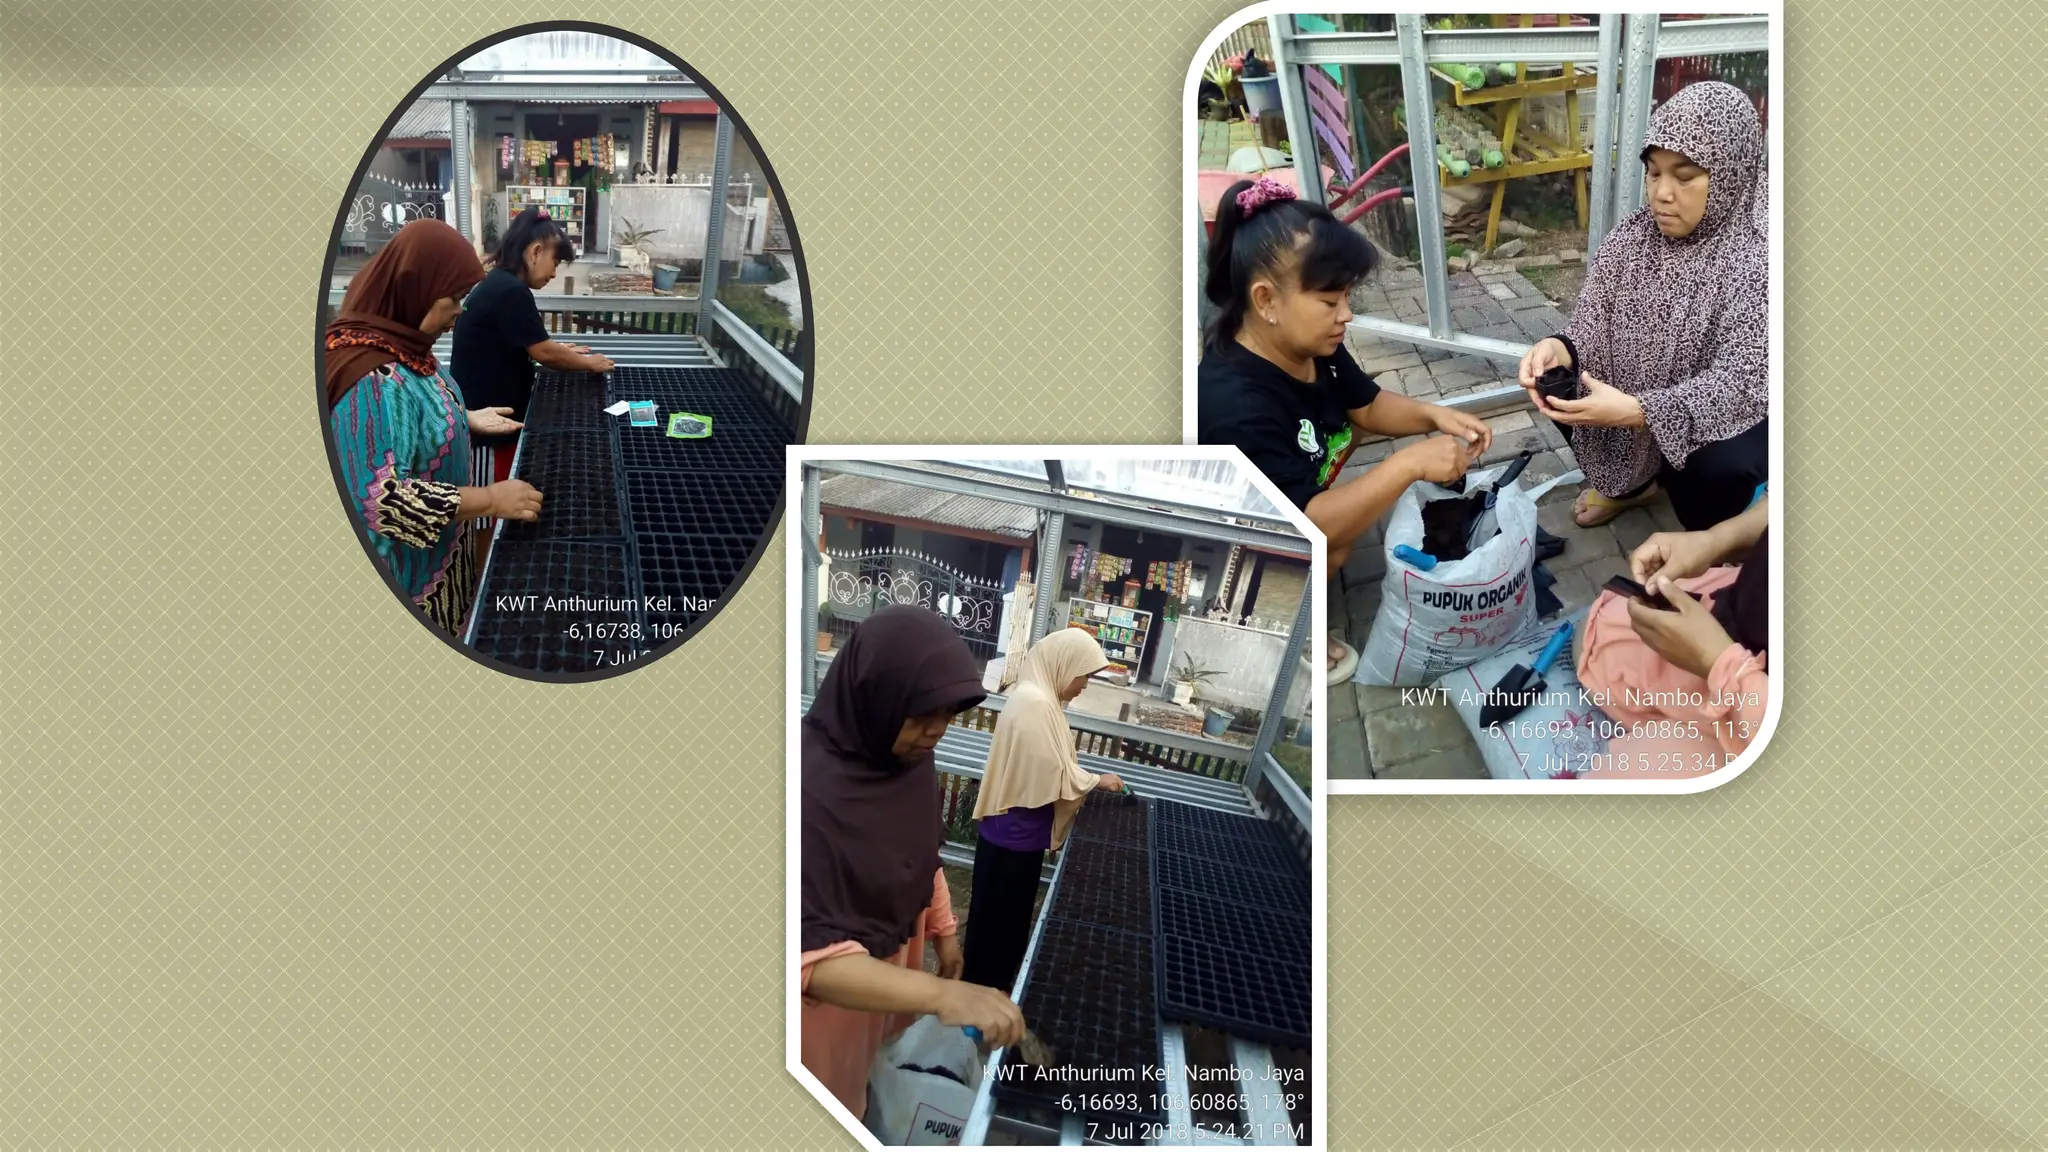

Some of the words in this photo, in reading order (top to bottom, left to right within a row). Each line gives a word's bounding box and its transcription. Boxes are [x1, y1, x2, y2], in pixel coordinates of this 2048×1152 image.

[1423, 591, 1474, 612] PUPUK
[1477, 568, 1527, 609] ORGANIK
[1460, 606, 1504, 624] SUPER
[925, 1119, 962, 1139] PUPUK
